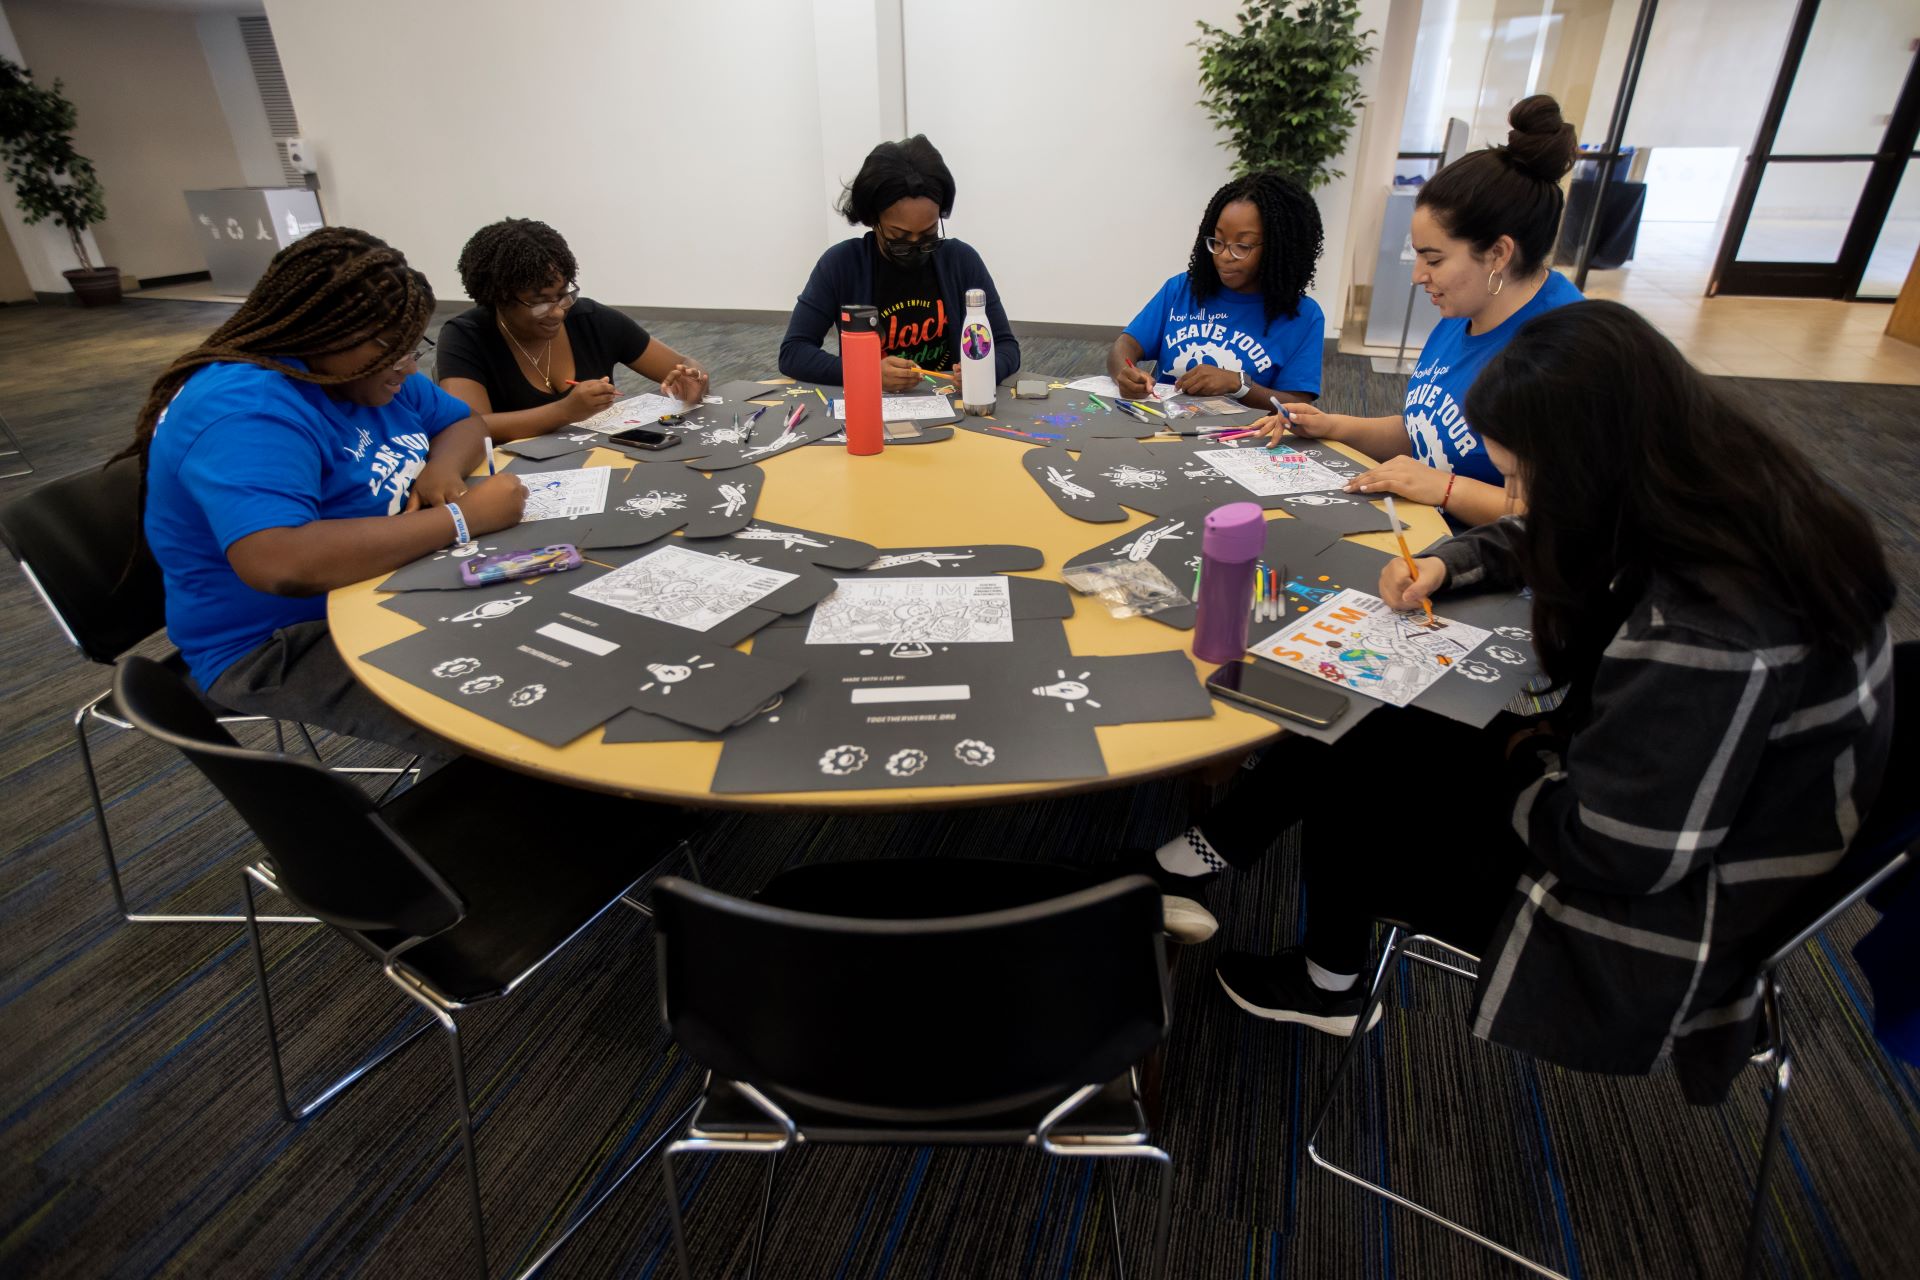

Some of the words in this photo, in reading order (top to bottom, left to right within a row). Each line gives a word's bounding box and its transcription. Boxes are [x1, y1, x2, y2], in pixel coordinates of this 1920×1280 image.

[881, 302, 904, 318] INLAND
[907, 299, 931, 308] EMPIRE
[881, 299, 948, 350] lack
[1189, 307, 1206, 321] will
[1208, 312, 1229, 324] you
[1165, 323, 1227, 349] LEAVE
[1229, 330, 1272, 374] YOUR
[1405, 383, 1442, 410] EAVE
[1436, 393, 1478, 457] YOUR
[1272, 606, 1368, 662] STEM
